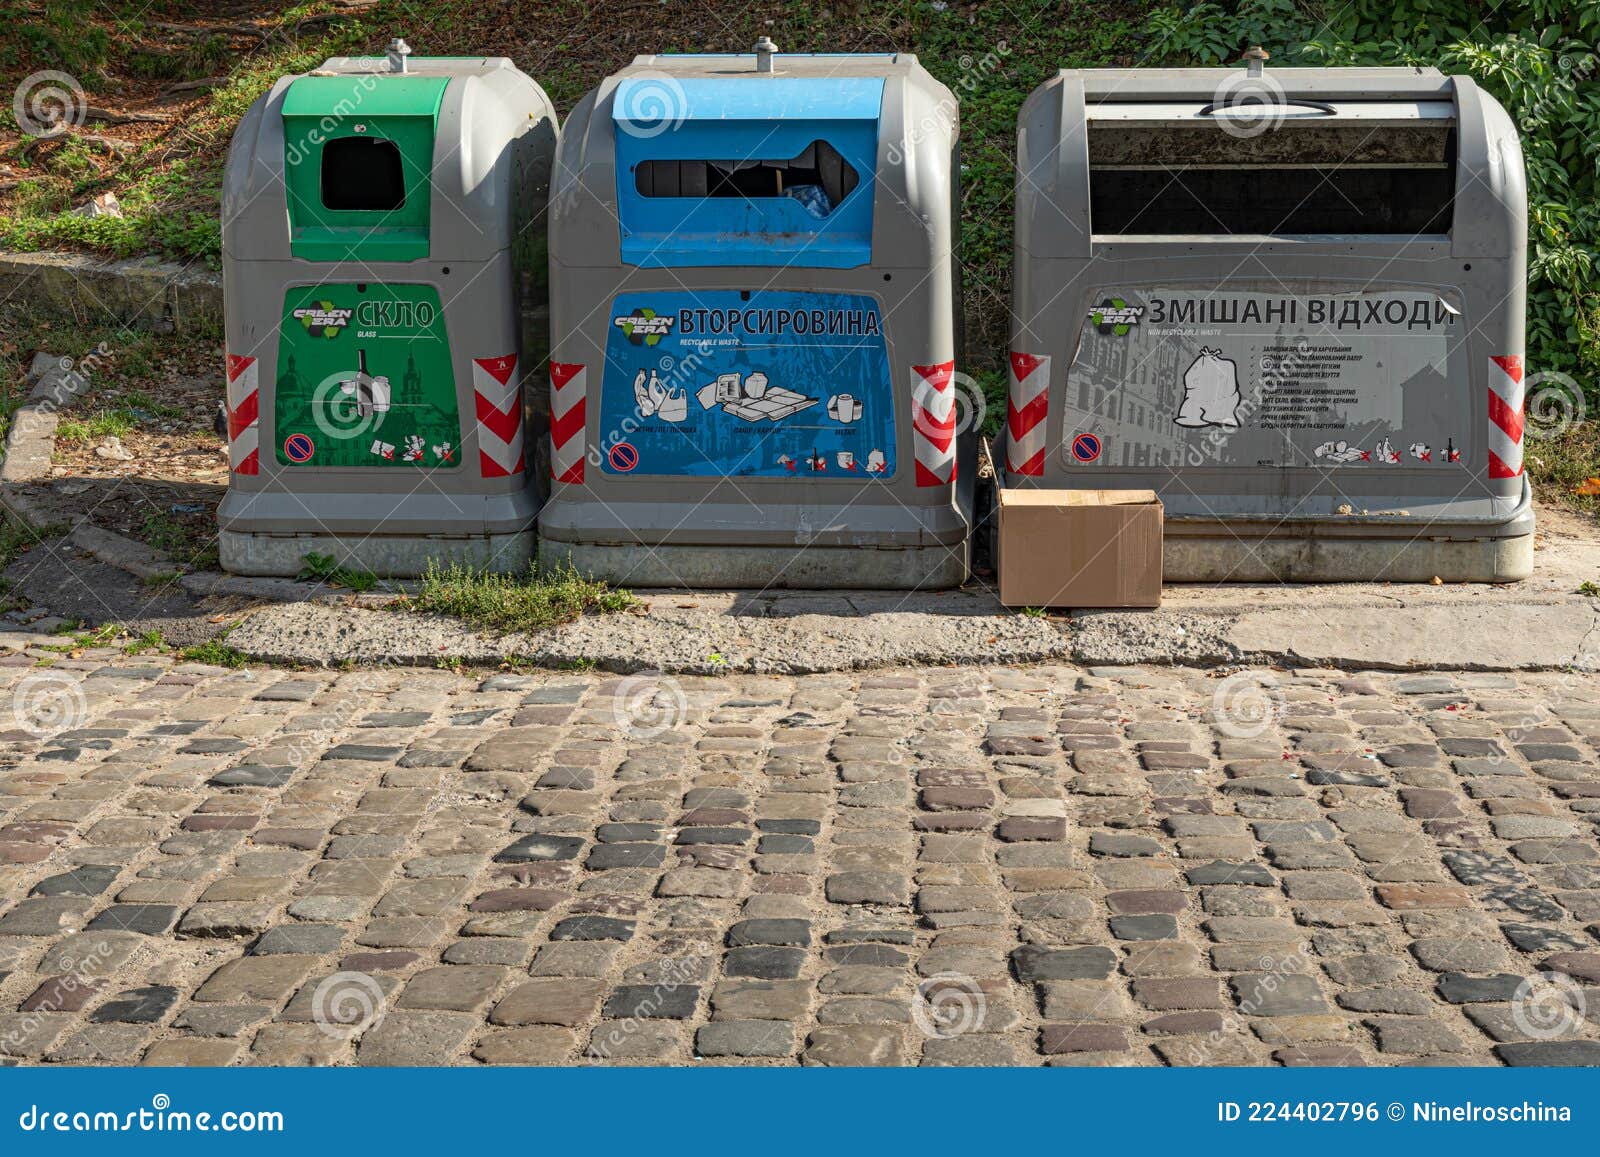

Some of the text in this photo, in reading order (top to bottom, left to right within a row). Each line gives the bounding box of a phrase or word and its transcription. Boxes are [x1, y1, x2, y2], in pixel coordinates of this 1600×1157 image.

[293, 309, 352, 318] GREEN
[356, 301, 435, 328] СКЛО
[1149, 299, 1454, 330] ЗМІШАНІ ВІДХОДИ
[311, 318, 347, 326] ERA
[614, 316, 674, 326] GREEN
[679, 308, 879, 336] ВТОРСИРОВИНА
[1101, 315, 1138, 324] ERA
[357, 330, 376, 338] GLASS
[632, 325, 669, 334] ERA
[680, 338, 718, 346] RECYCLABLE
